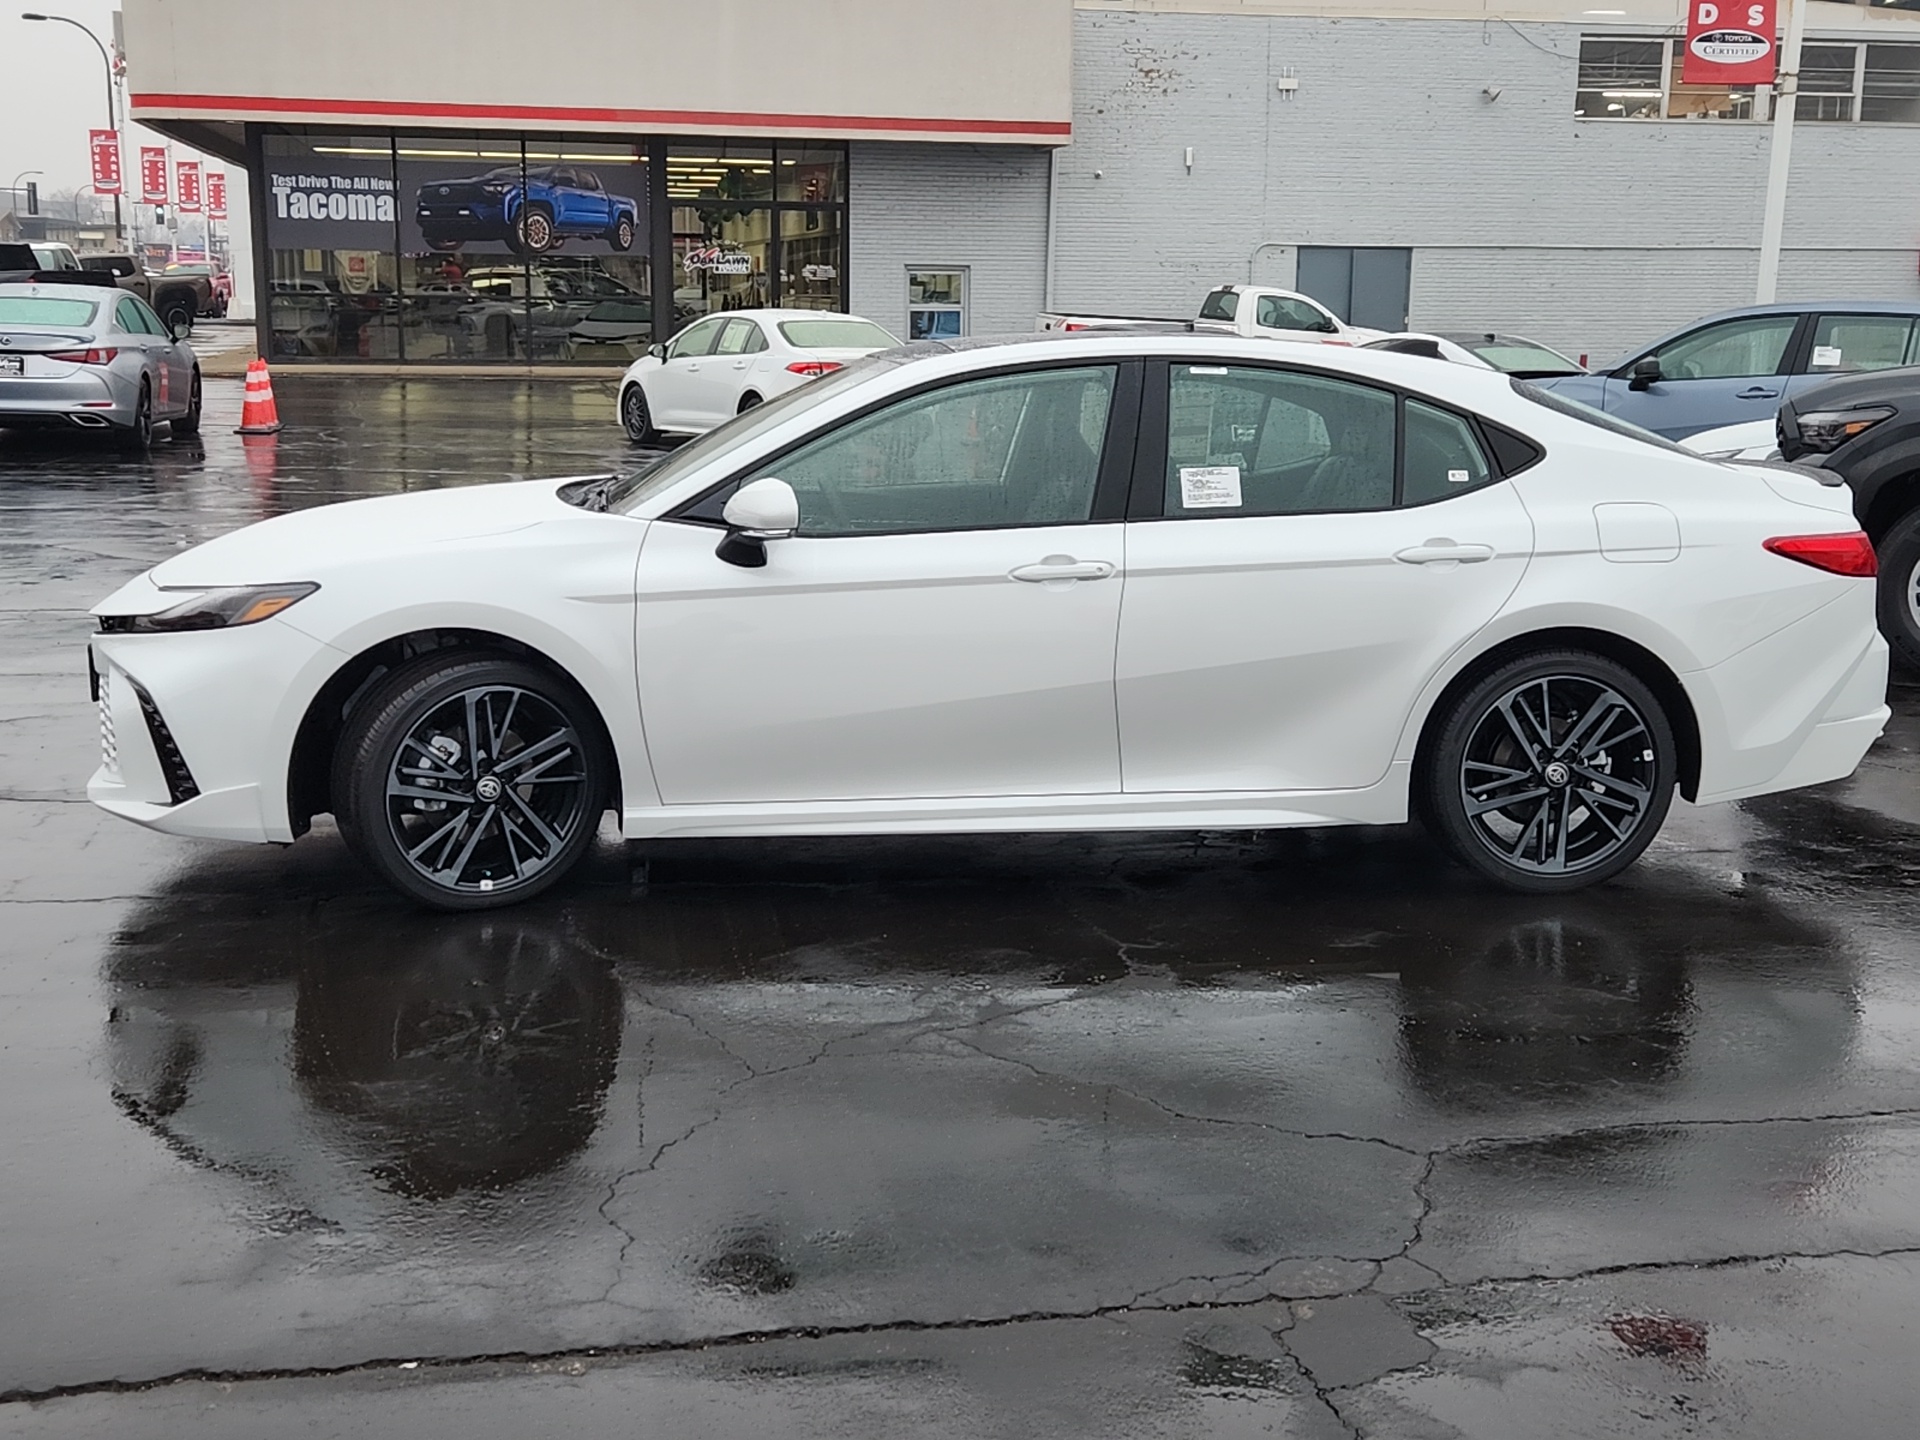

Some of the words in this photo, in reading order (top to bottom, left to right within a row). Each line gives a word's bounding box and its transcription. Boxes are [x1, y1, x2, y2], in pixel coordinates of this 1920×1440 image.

[1724, 34, 1753, 42] TOYOTA
[93, 146, 103, 179] USED
[109, 146, 118, 179] CARS
[143, 161, 152, 191] USED
[157, 161, 165, 191] CARS
[271, 174, 297, 187] Test
[298, 175, 329, 189] Drive
[330, 176, 352, 189] The
[353, 177, 369, 190] All
[370, 178, 400, 190] New
[272, 186, 401, 221] Tacoma
